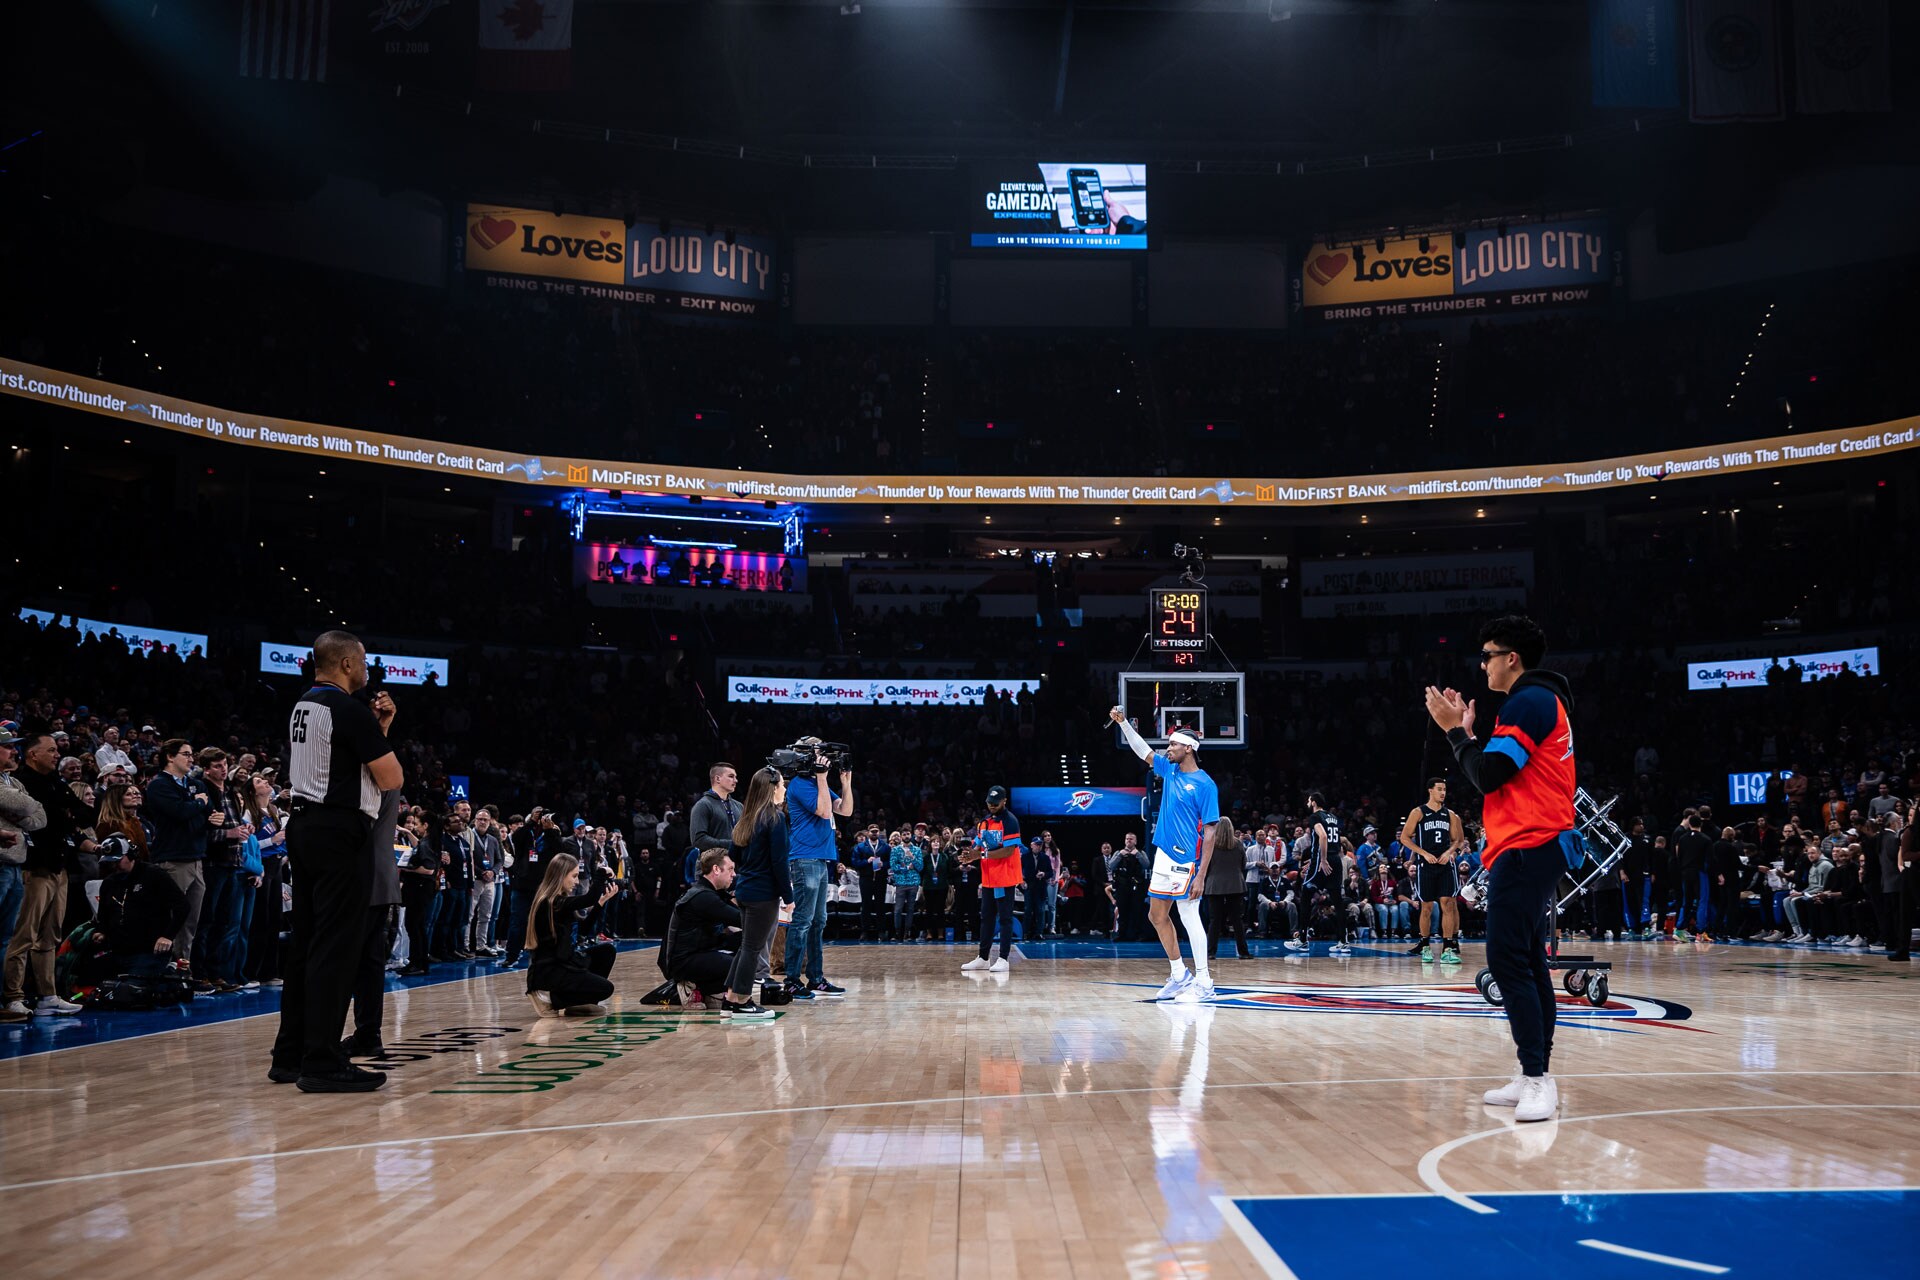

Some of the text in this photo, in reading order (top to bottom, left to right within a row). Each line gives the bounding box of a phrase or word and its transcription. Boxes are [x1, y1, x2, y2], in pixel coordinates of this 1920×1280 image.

[1000, 182, 1045, 192] ELEVATE YOUR
[986, 192, 1059, 211] GAMEDAY
[1031, 237, 1060, 245] THUNDER
[632, 236, 770, 290] LOUD CITY
[1460, 230, 1602, 286] LOUD CITY
[486, 276, 756, 315] BRING THE THUNDER EXIT NOW
[1324, 289, 1589, 320] BRING THE THUNDER EXIT NOW
[150, 403, 505, 474] Thunder Up Your Rewards With The Thunder Credit Card
[1563, 428, 1914, 486] Thunder Up Your Rewards With The Thunder Credit Card
[726, 479, 858, 498] midfirst.com/thunder
[877, 484, 1196, 500] Thunder Up Your Rewards With The Thunder Credit Card
[1408, 473, 1544, 495] midfirst.com/thunder
[729, 567, 784, 587] TERRAC
[1163, 594, 1199, 609] 12:00
[1162, 609, 1195, 634] 24
[1175, 653, 1193, 665] 1:27
[292, 708, 310, 744] 25
[1327, 826, 1339, 843] 35
[1424, 820, 1450, 831] ORLANDO
[1435, 830, 1442, 843] 2
